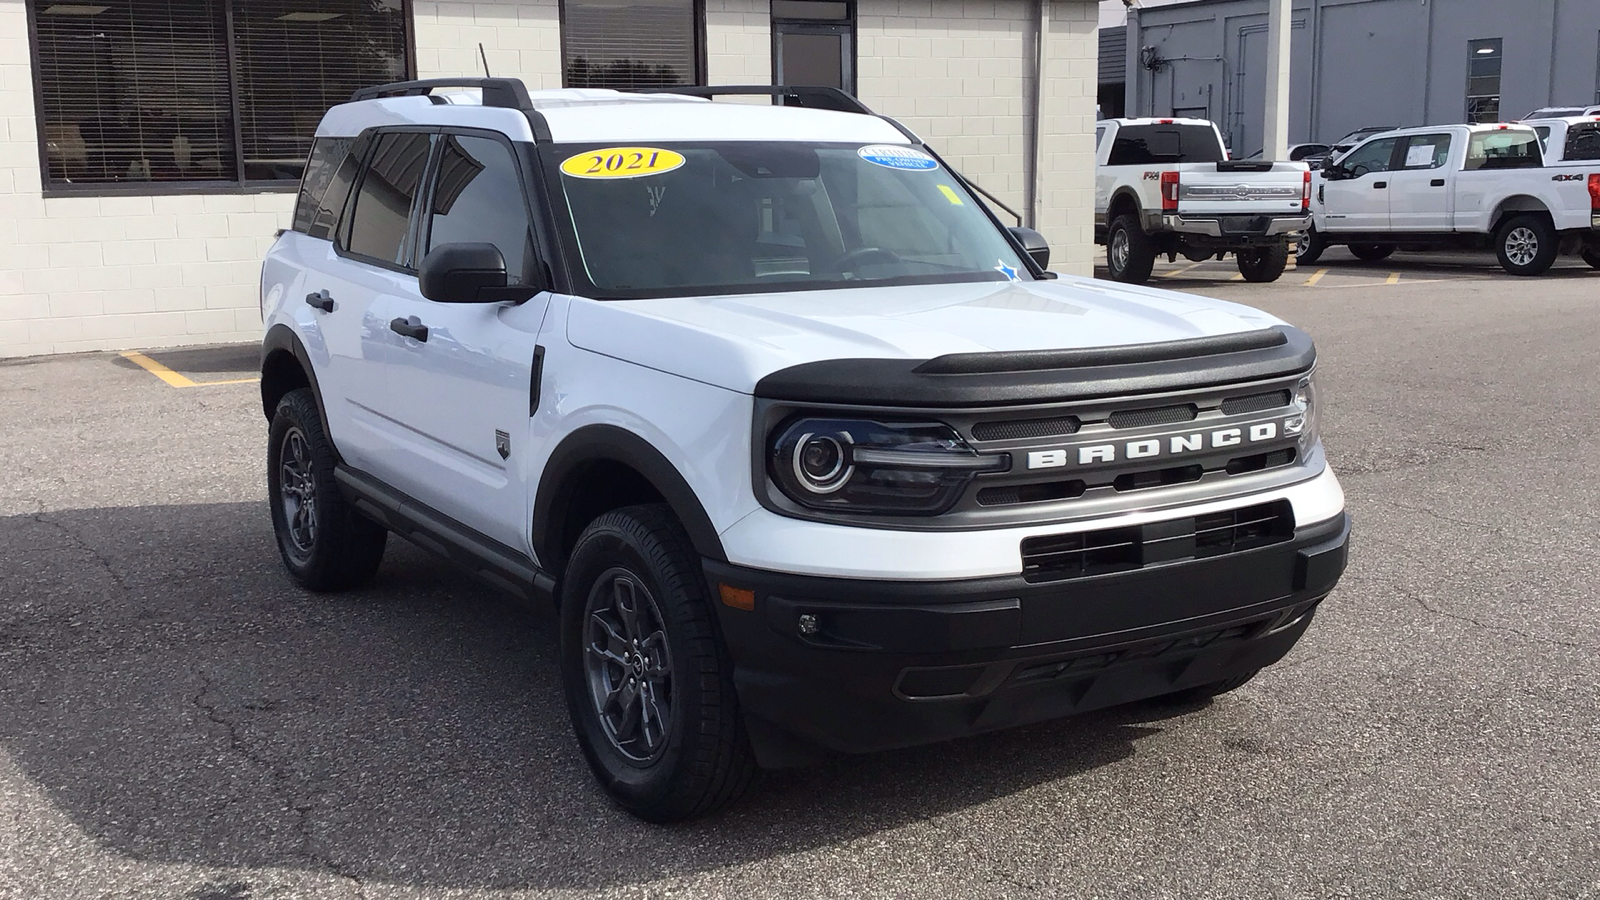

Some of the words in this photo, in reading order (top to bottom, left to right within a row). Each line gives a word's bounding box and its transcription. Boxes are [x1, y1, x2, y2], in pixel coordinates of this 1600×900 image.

[864, 147, 926, 160] CERTIFIED
[585, 151, 660, 175] 2021
[888, 161, 928, 169] VEHICLE
[1143, 171, 1160, 181] FX4
[1027, 422, 1277, 470] BRONCO
